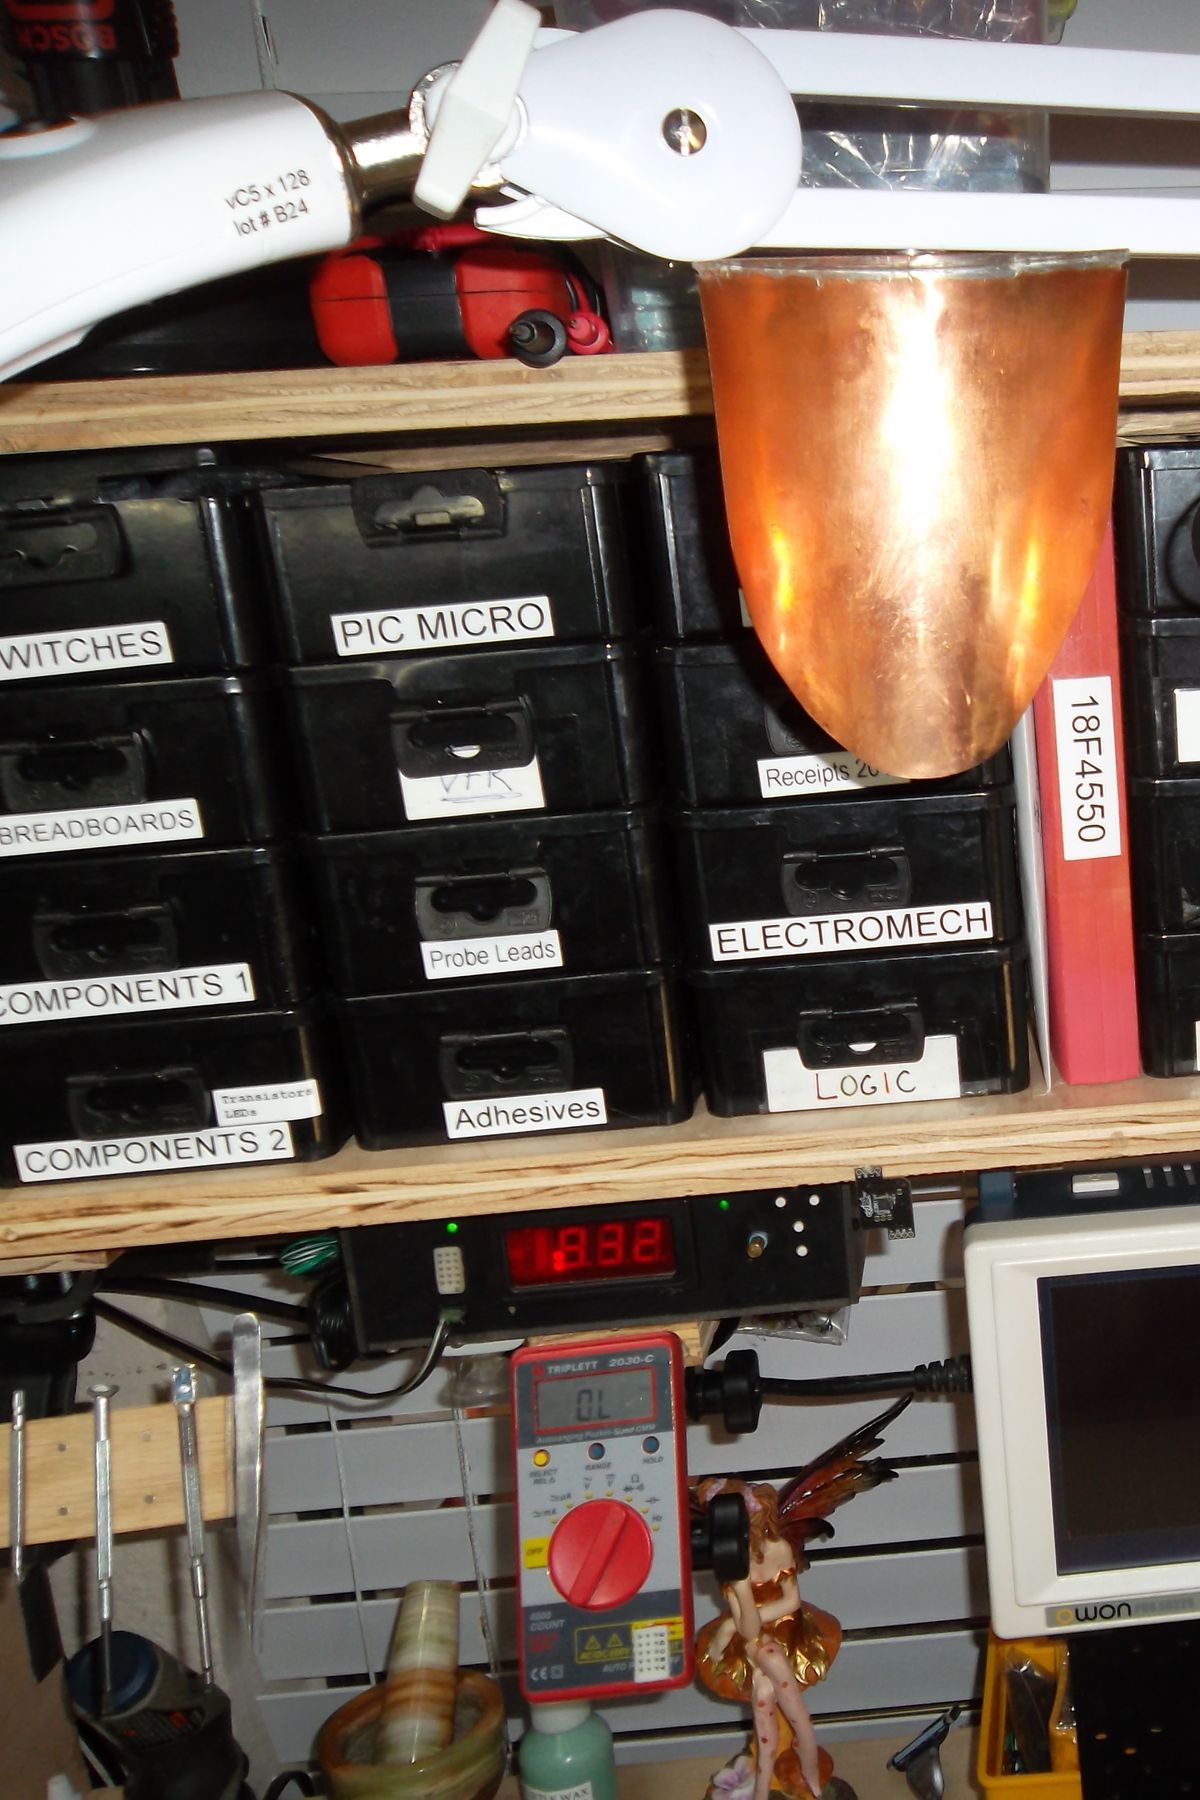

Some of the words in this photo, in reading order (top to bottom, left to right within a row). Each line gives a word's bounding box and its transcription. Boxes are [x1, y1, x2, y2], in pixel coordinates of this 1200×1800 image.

[278, 169, 310, 192] 128
[233, 216, 258, 235] lot
[273, 198, 308, 223] B24
[341, 616, 404, 647] PIC
[417, 603, 544, 640] MICRO
[0, 630, 163, 671] WITCHES
[766, 763, 850, 789] Receipts
[1071, 695, 1106, 842] 18F4550
[0, 809, 194, 846] BREADBOARDS
[717, 907, 988, 955] ELECTROMECH
[430, 947, 489, 970] Probe
[495, 941, 557, 963] Leads
[236, 971, 250, 994] 1
[221, 1087, 313, 1104] Transistors
[816, 1070, 917, 1101] LOGIC
[455, 1099, 601, 1130] Adhesives
[25, 1130, 259, 1174] COMPONENTS
[269, 1129, 287, 1151] 2
[547, 1361, 598, 1375] TRIPLETT
[609, 1354, 655, 1368] 2030-C
[531, 1619, 566, 1632] COUNT
